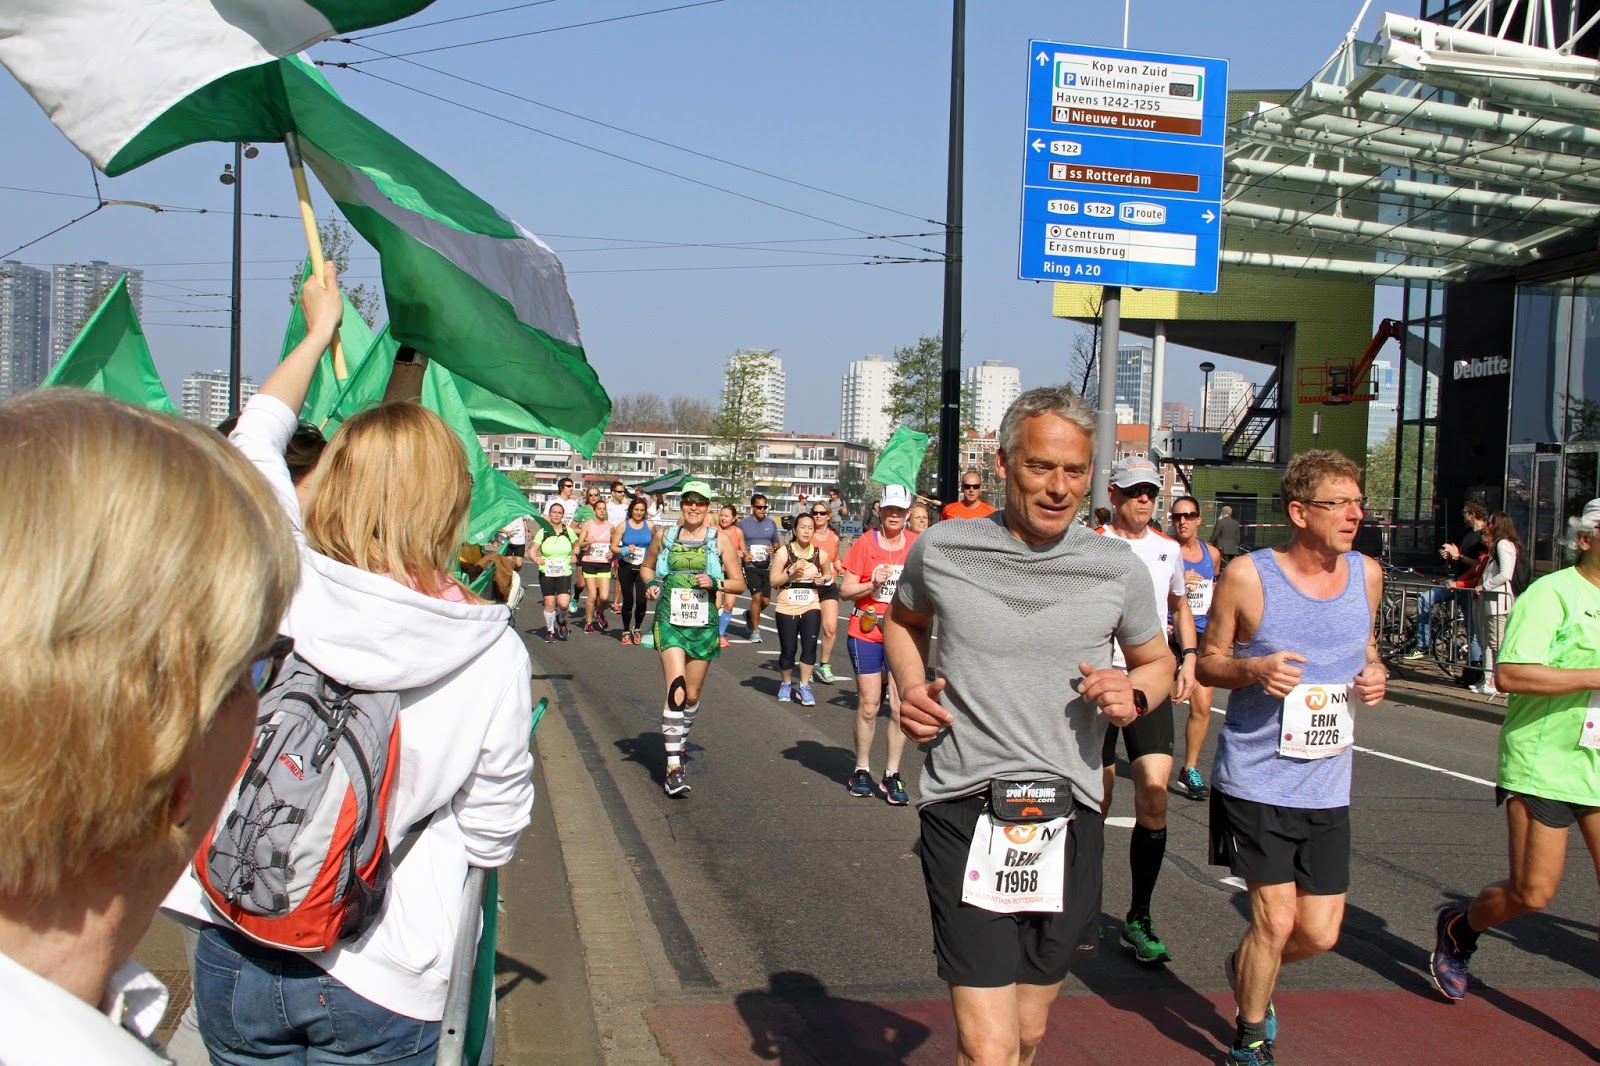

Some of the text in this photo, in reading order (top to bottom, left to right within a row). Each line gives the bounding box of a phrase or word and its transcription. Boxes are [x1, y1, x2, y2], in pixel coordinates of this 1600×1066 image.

[1092, 60, 1168, 77] Kop van Zuid
[1080, 75, 1165, 95] Wilhelminapier
[1056, 92, 1160, 111] Havens 1242-1255
[1072, 110, 1156, 129] Nieuwe Luxor
[1053, 144, 1078, 153] S 122
[1069, 168, 1151, 185] ss Rotterdam
[1050, 202, 1076, 212] S 106
[1087, 205, 1111, 215] S 122
[1136, 209, 1162, 219] route
[1065, 227, 1115, 241] Centrum
[1049, 241, 1125, 259] Erasmusbrug
[1043, 261, 1070, 276] Ring
[1163, 437, 1182, 452] 111
[1311, 713, 1337, 727] ERIK
[1304, 729, 1339, 746] 12226
[995, 869, 1038, 893] 11968
[1012, 896, 1044, 904] ROTTERDAM
